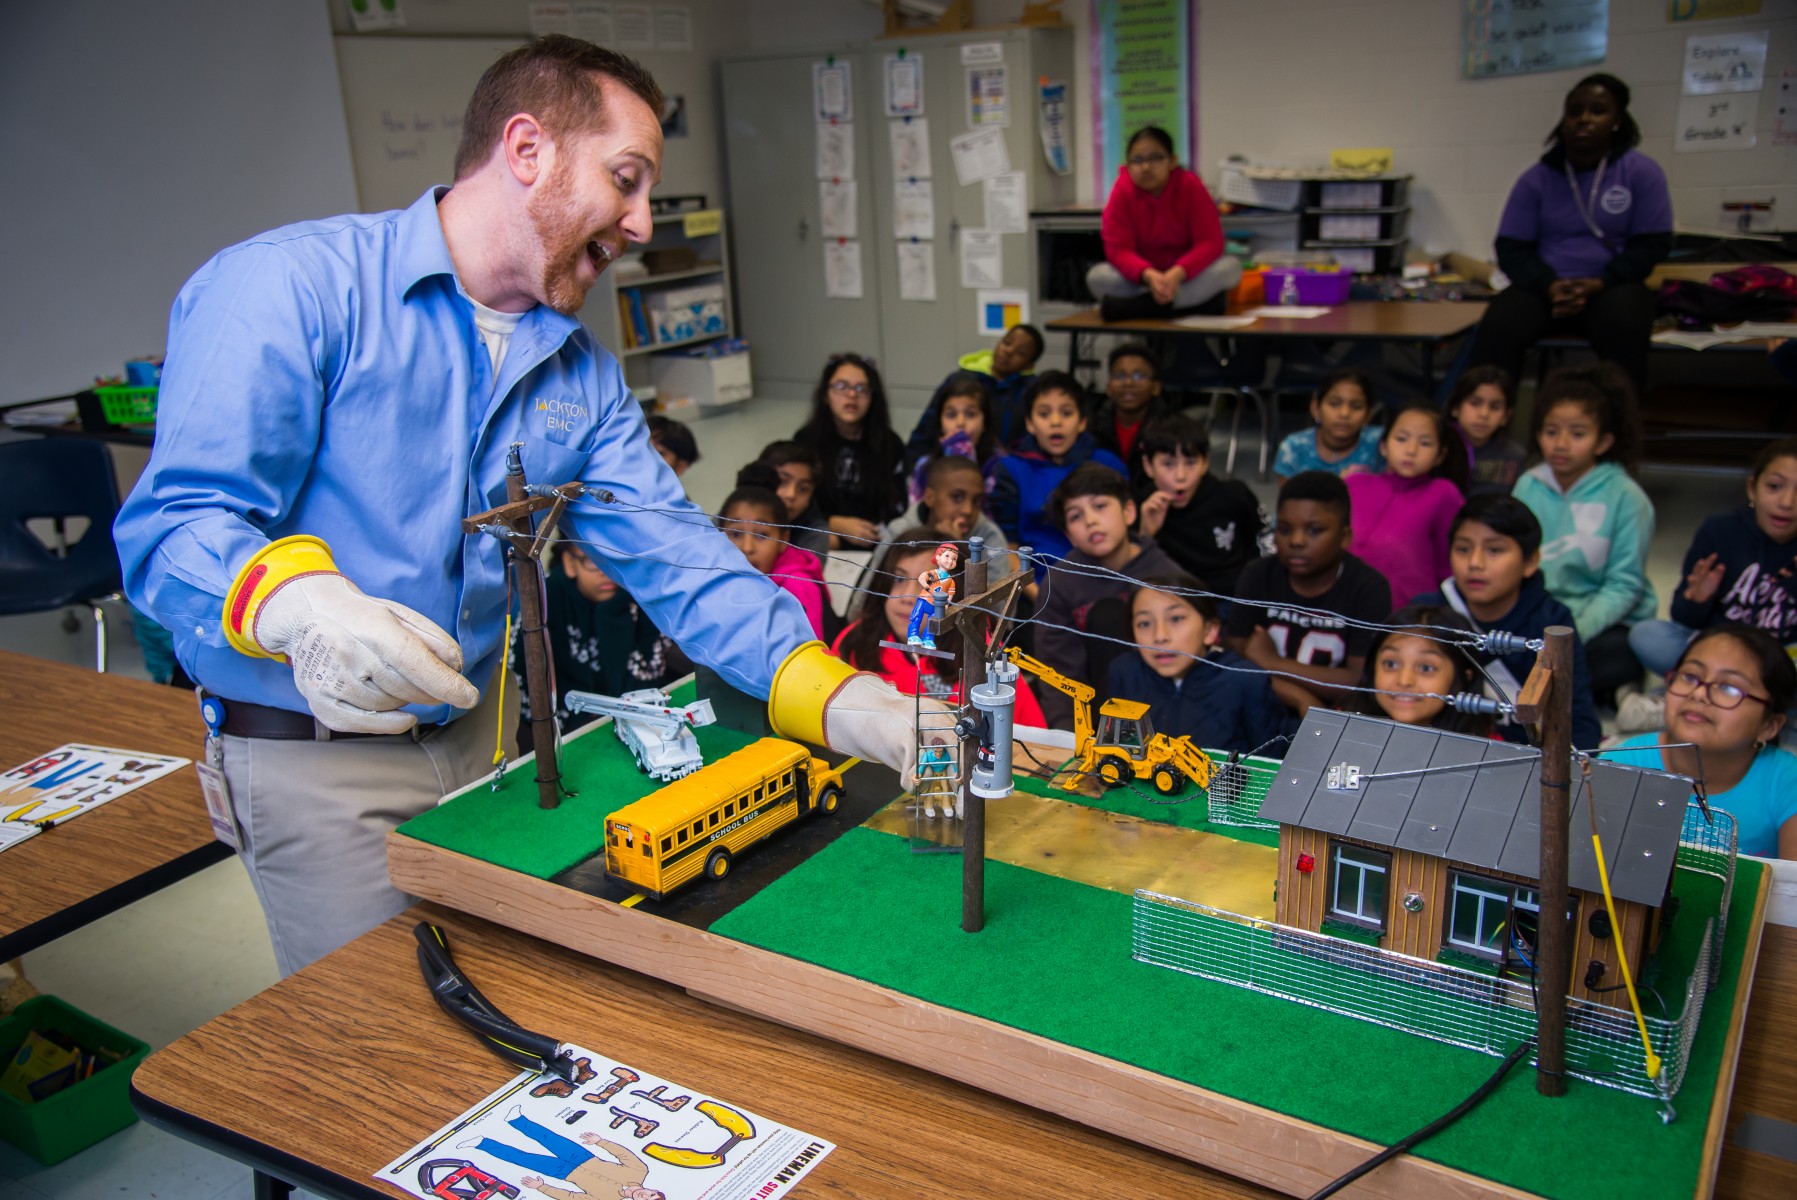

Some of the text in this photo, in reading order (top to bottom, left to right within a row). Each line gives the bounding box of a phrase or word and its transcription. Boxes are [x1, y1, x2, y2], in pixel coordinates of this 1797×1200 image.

[1692, 46, 1741, 60] Explore
[1683, 125, 1728, 141] Grade
[534, 398, 588, 418] JACKSON
[547, 416, 575, 432] EMC
[1266, 608, 1346, 628] FALCONS
[710, 810, 759, 842] SCHOOL BUS
[774, 1142, 826, 1184] LINEMAN
[756, 1182, 778, 1199] SUIT
